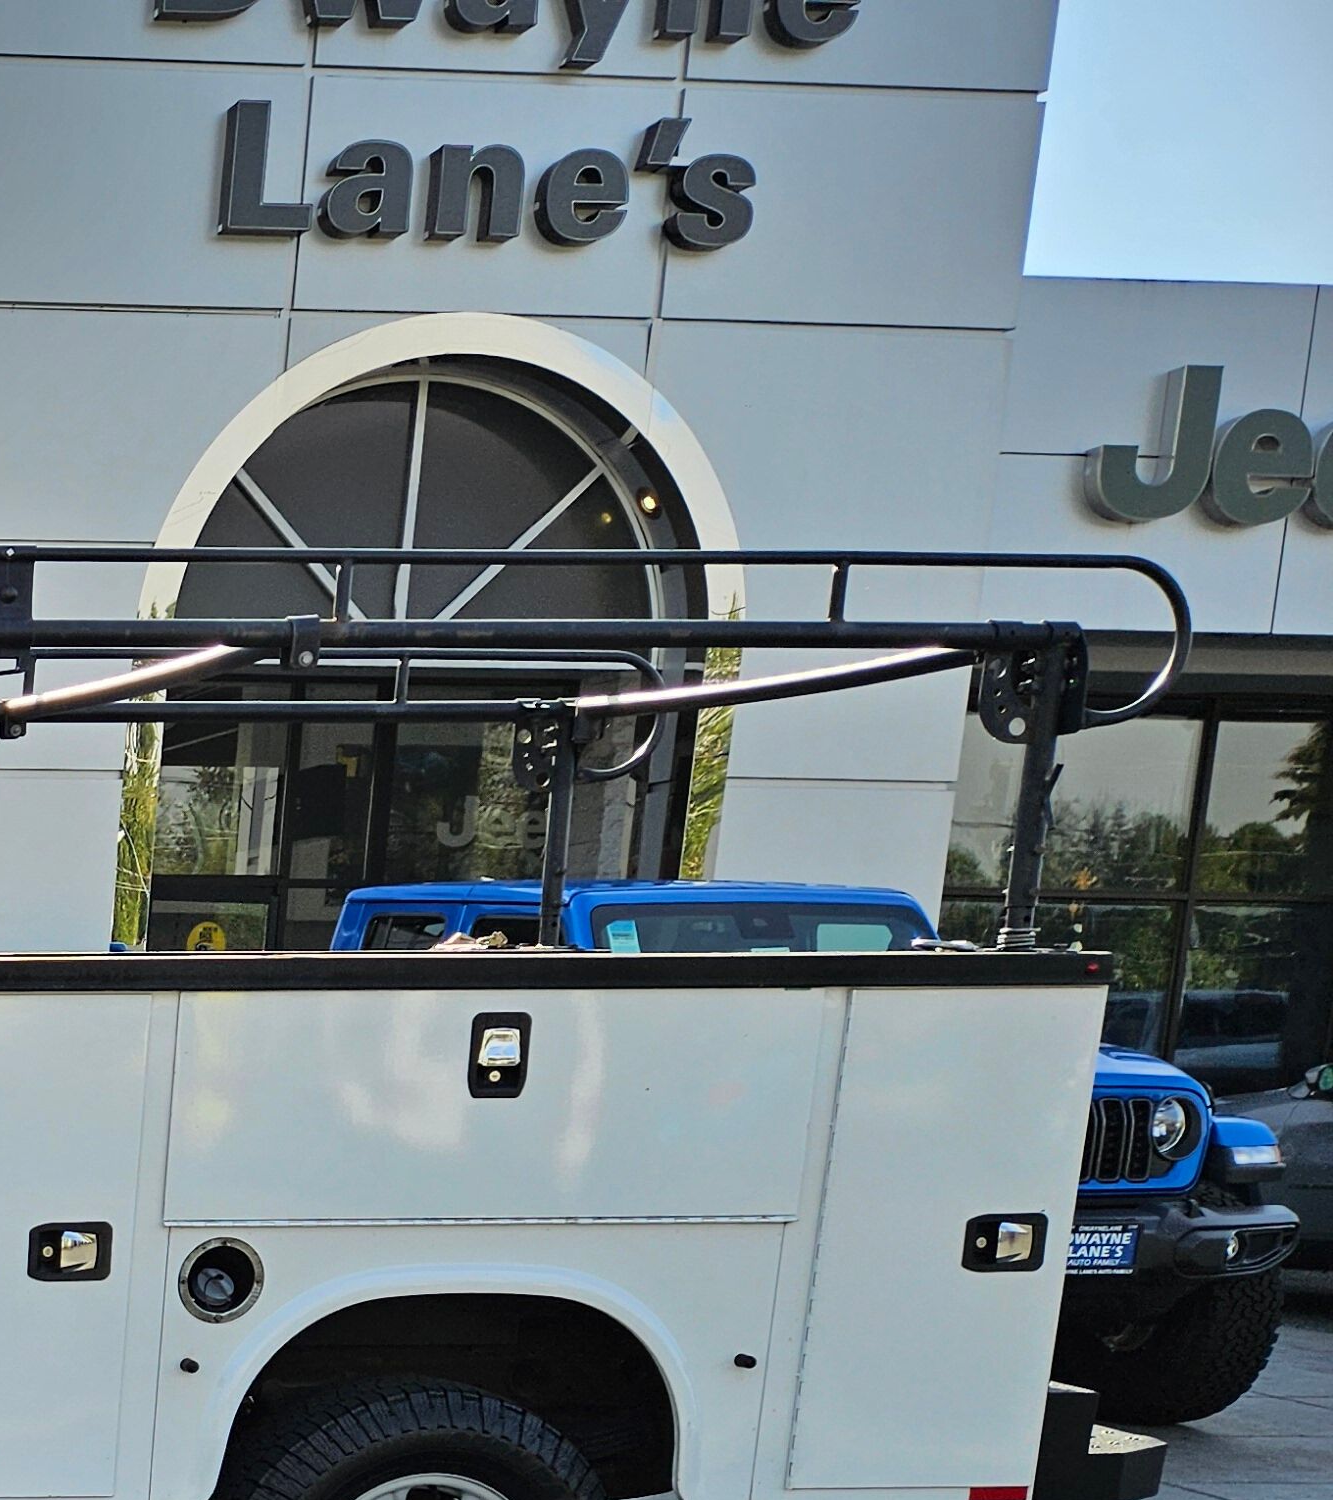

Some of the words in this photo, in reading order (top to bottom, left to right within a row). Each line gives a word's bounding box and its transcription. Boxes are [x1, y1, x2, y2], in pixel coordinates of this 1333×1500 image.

[217, 99, 757, 252] Lane's
[1084, 365, 1333, 530] Je
[436, 795, 548, 848] Jee
[1068, 1246, 1123, 1257] LANE'S
